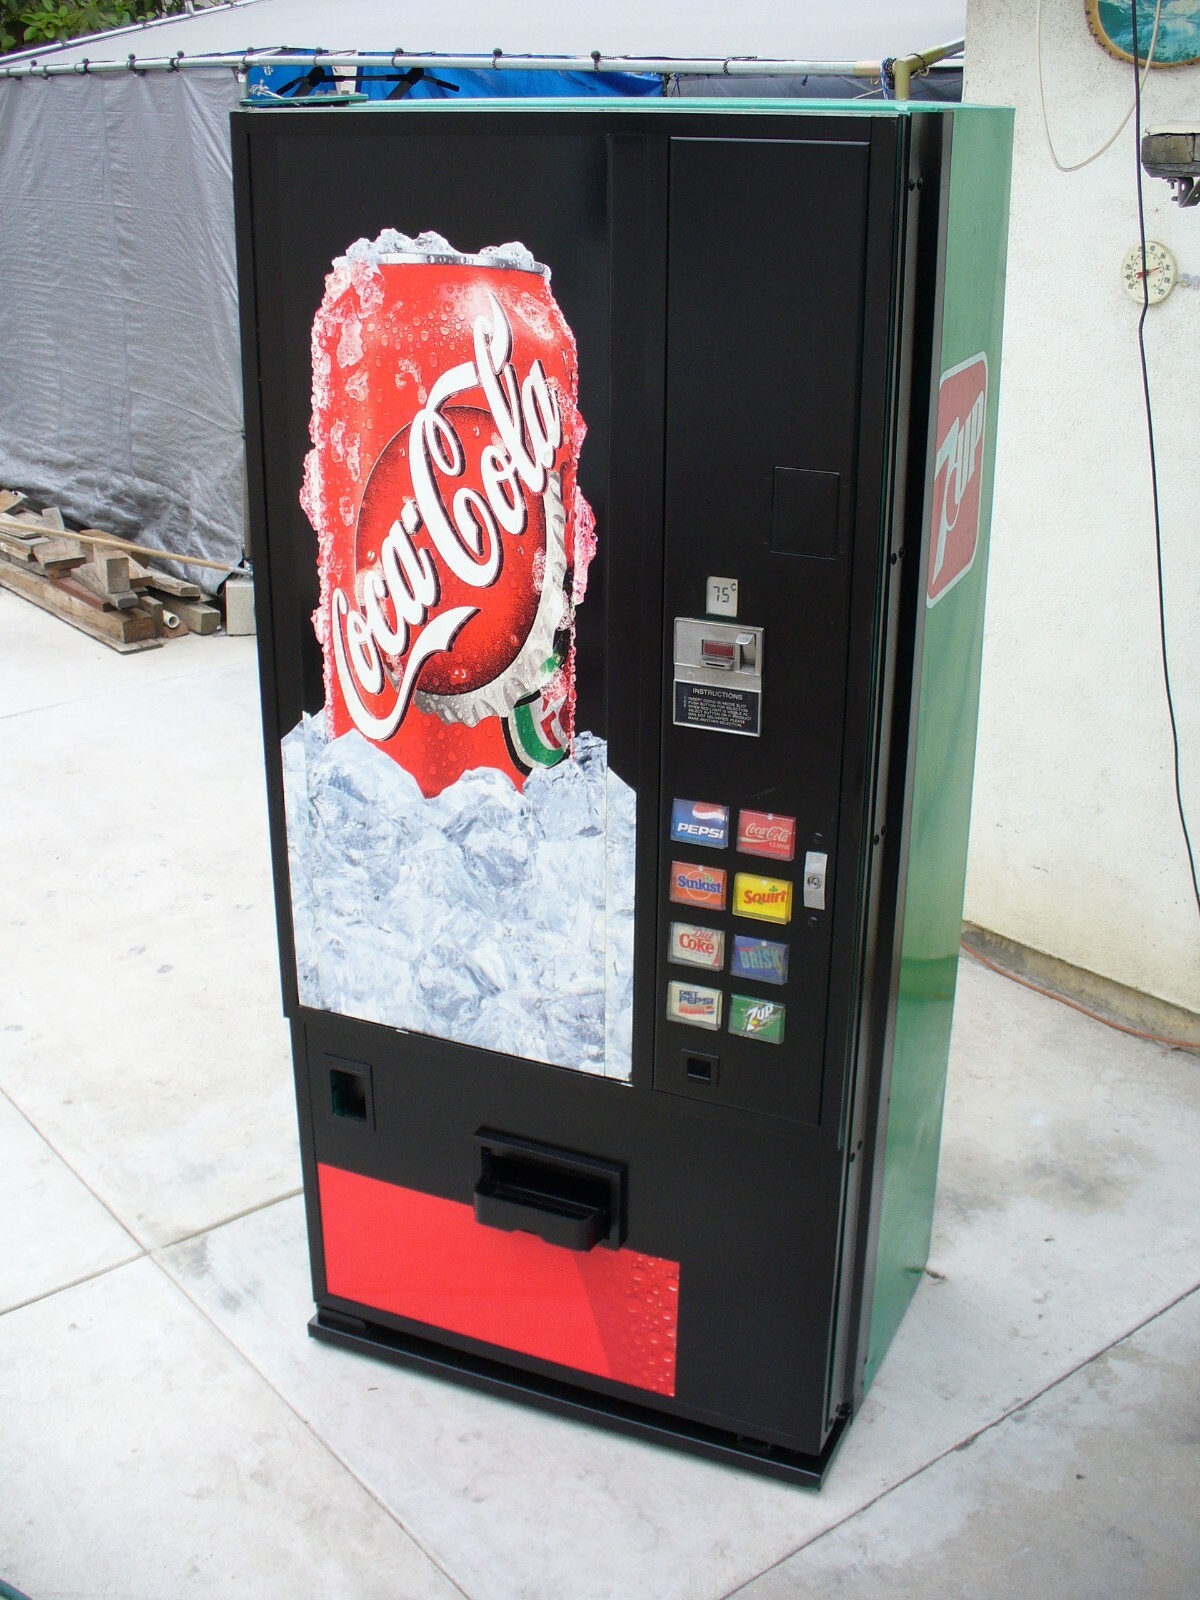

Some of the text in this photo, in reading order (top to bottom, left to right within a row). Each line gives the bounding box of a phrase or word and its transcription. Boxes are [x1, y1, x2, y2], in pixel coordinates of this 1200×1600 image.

[333, 290, 562, 740] Coca-Cola
[692, 688, 743, 700] INSTRUCTIONS
[677, 822, 724, 840] PEPSI
[677, 875, 722, 894] Sunkist
[743, 890, 788, 905] Squirt
[693, 927, 715, 941] Diet
[679, 933, 715, 954] Coke
[678, 989, 699, 998] DIET
[678, 995, 714, 1005] PEPSI
